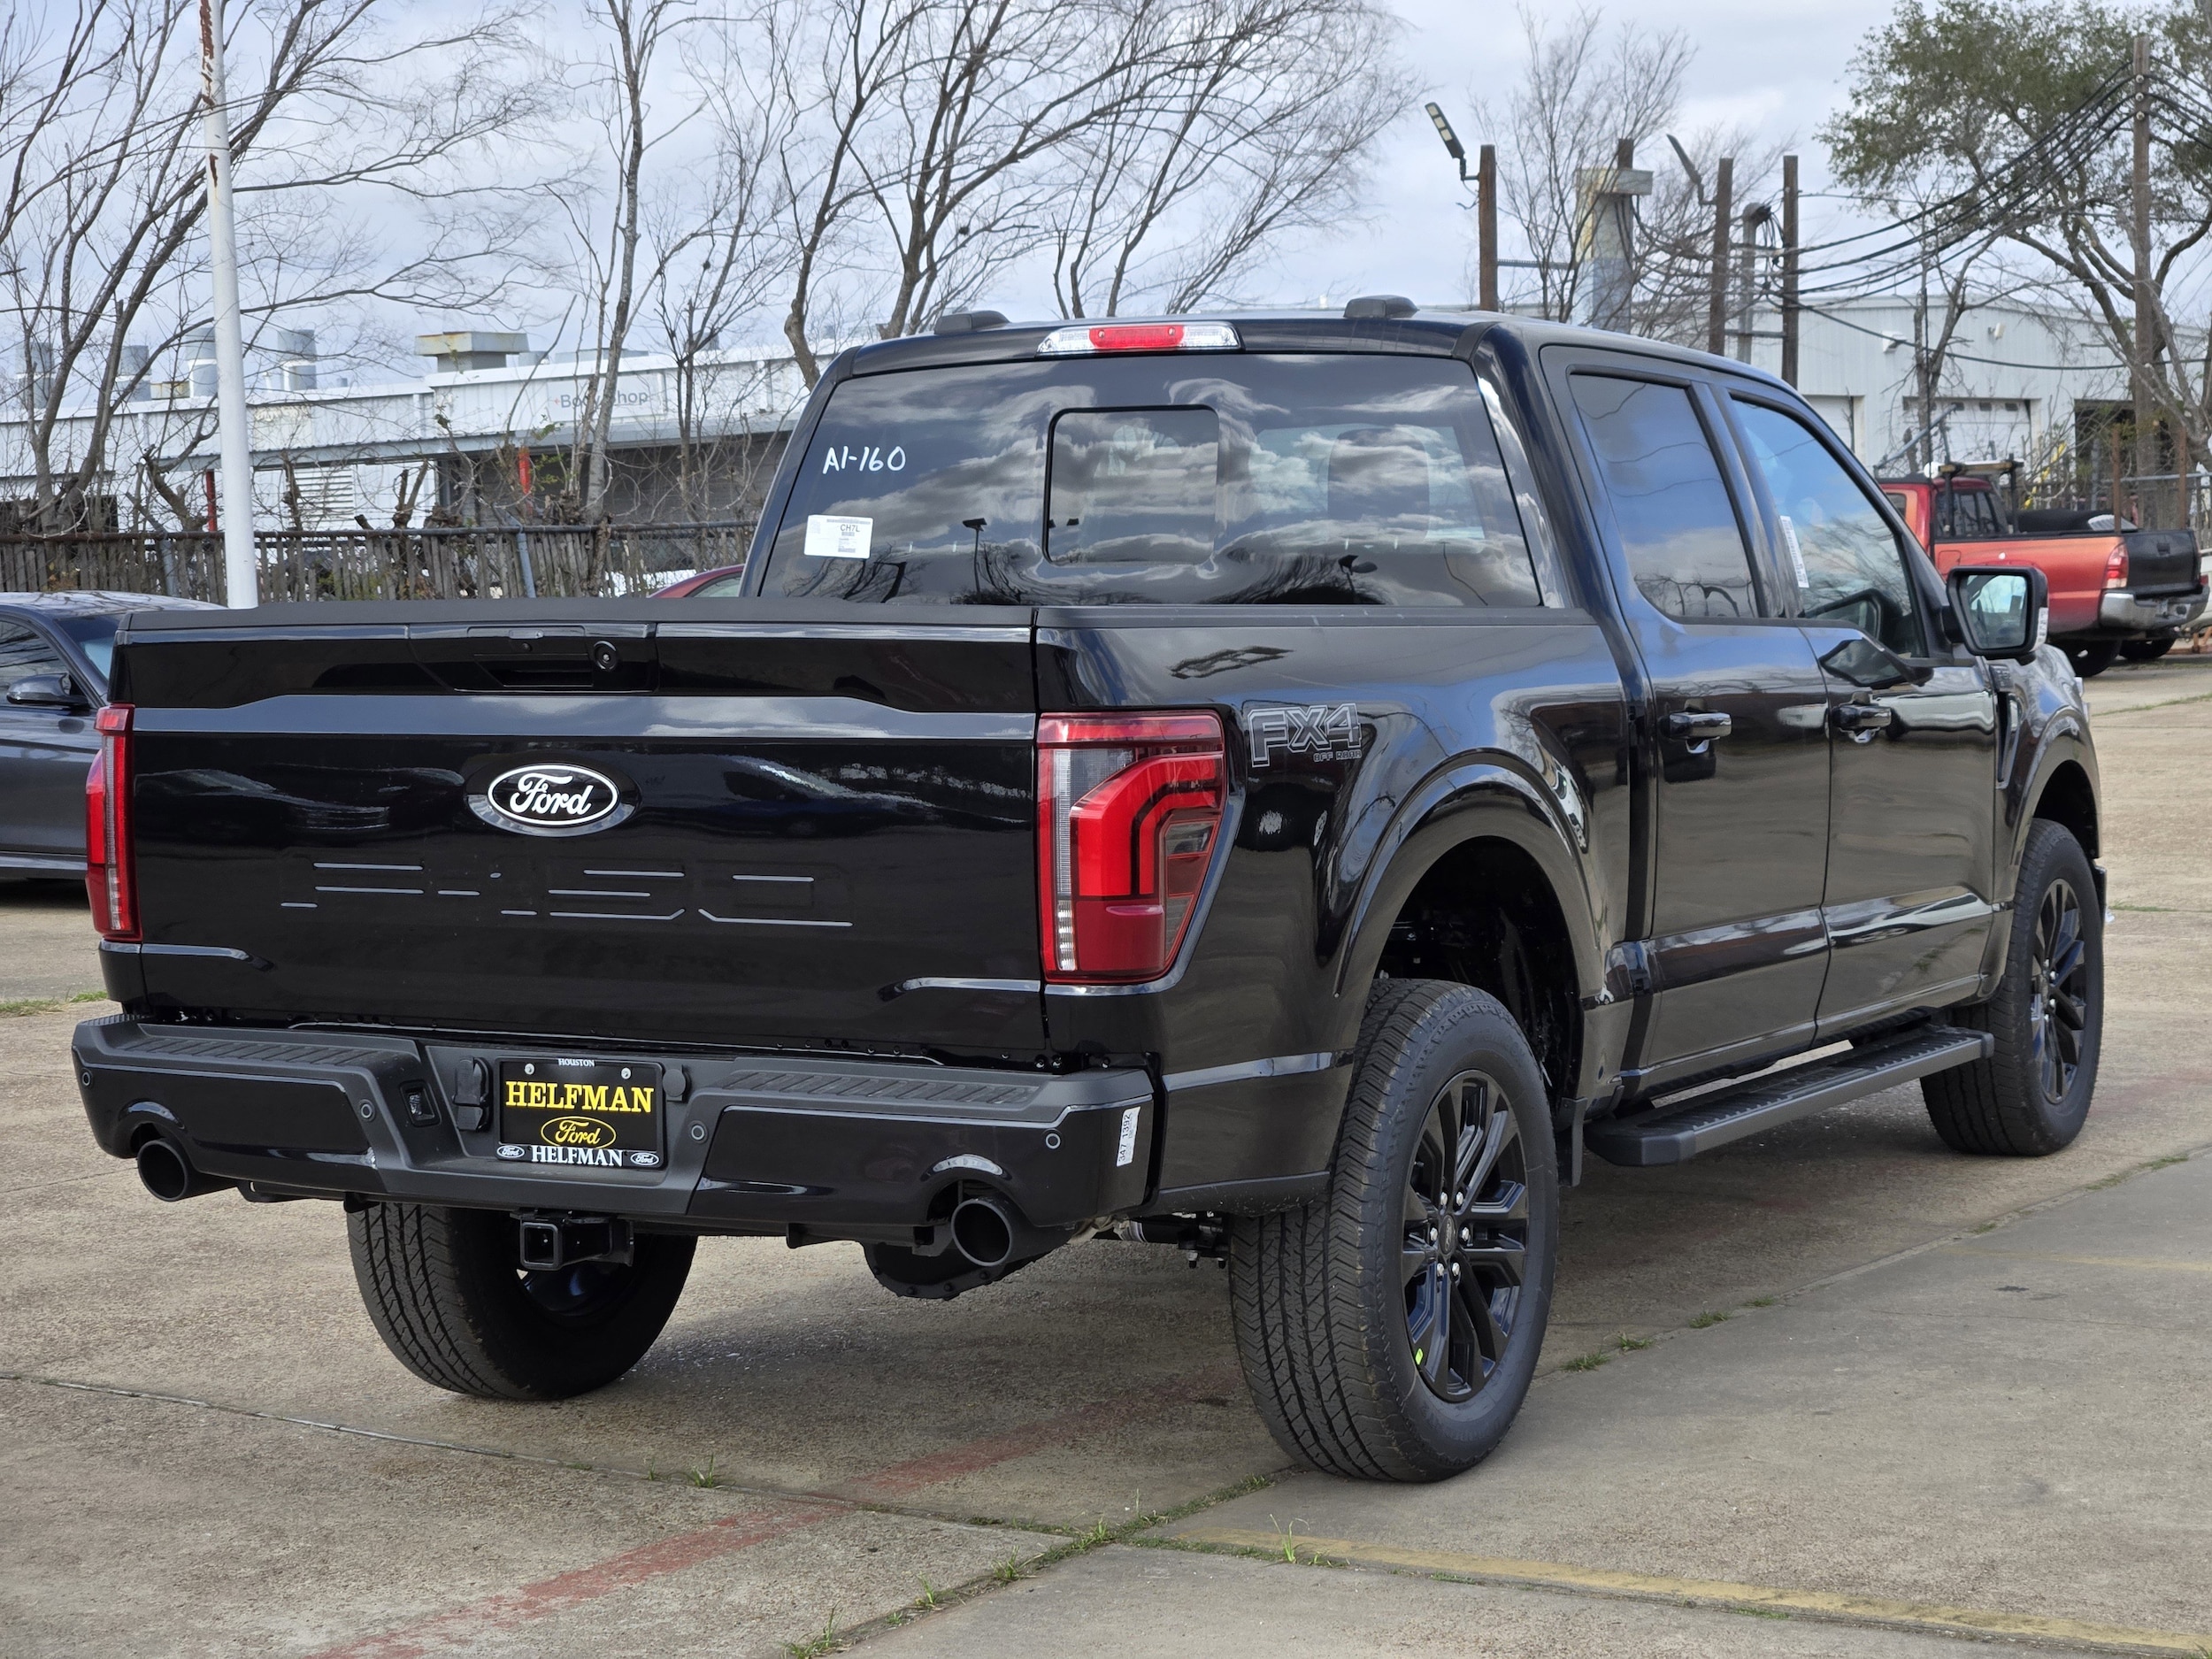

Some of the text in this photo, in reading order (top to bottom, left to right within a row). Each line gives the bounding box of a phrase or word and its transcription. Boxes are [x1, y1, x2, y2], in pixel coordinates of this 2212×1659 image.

[611, 389, 649, 405] hop
[1248, 703, 1363, 768] FX4
[1313, 752, 1333, 762] OFF
[510, 772, 595, 816] Ford
[557, 1058, 595, 1067] HOUSTON
[505, 1080, 655, 1113] HELFMAN
[554, 1118, 602, 1146] Ford
[531, 1145, 623, 1167] HELFMAN
